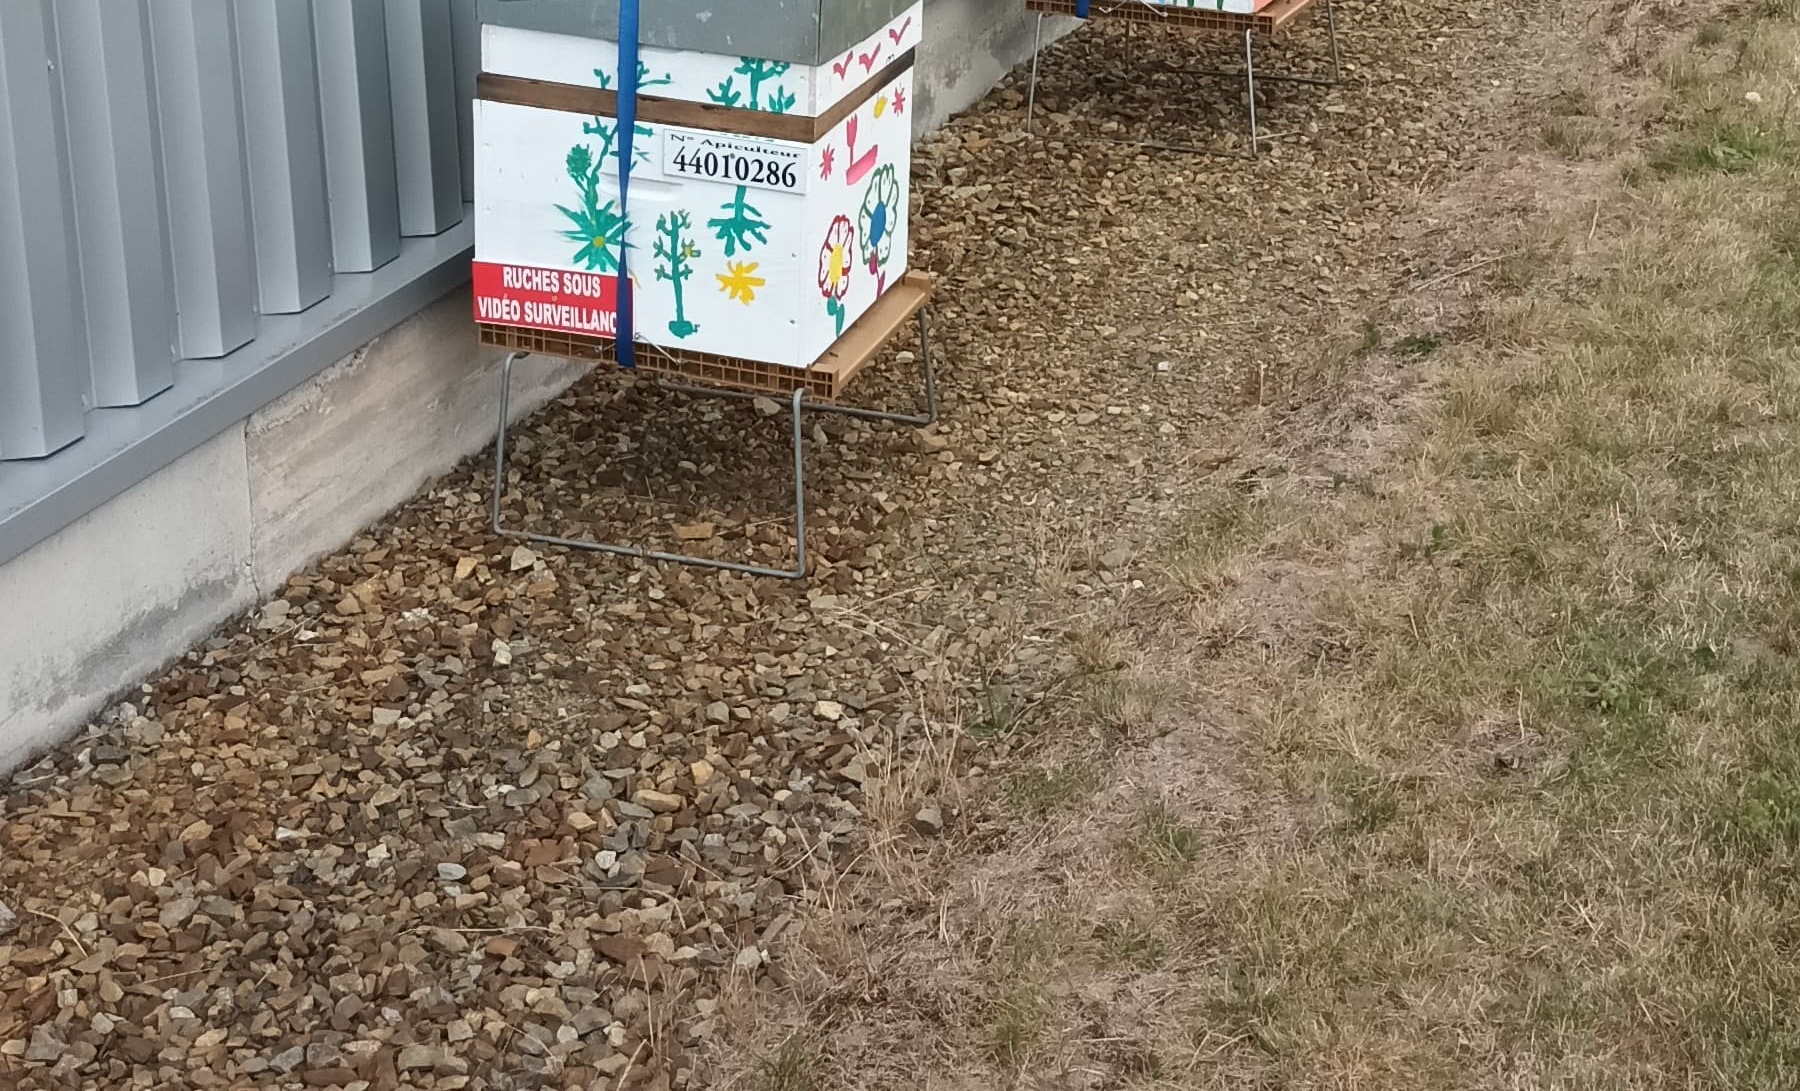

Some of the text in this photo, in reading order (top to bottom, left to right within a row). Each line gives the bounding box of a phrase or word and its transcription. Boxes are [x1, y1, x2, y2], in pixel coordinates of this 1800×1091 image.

[673, 145, 796, 188] 44010286
[701, 139, 801, 158] Apiculteur
[502, 266, 601, 299] RUCHES SOUS
[477, 294, 617, 334] VIDÉO SURVEILLANC
